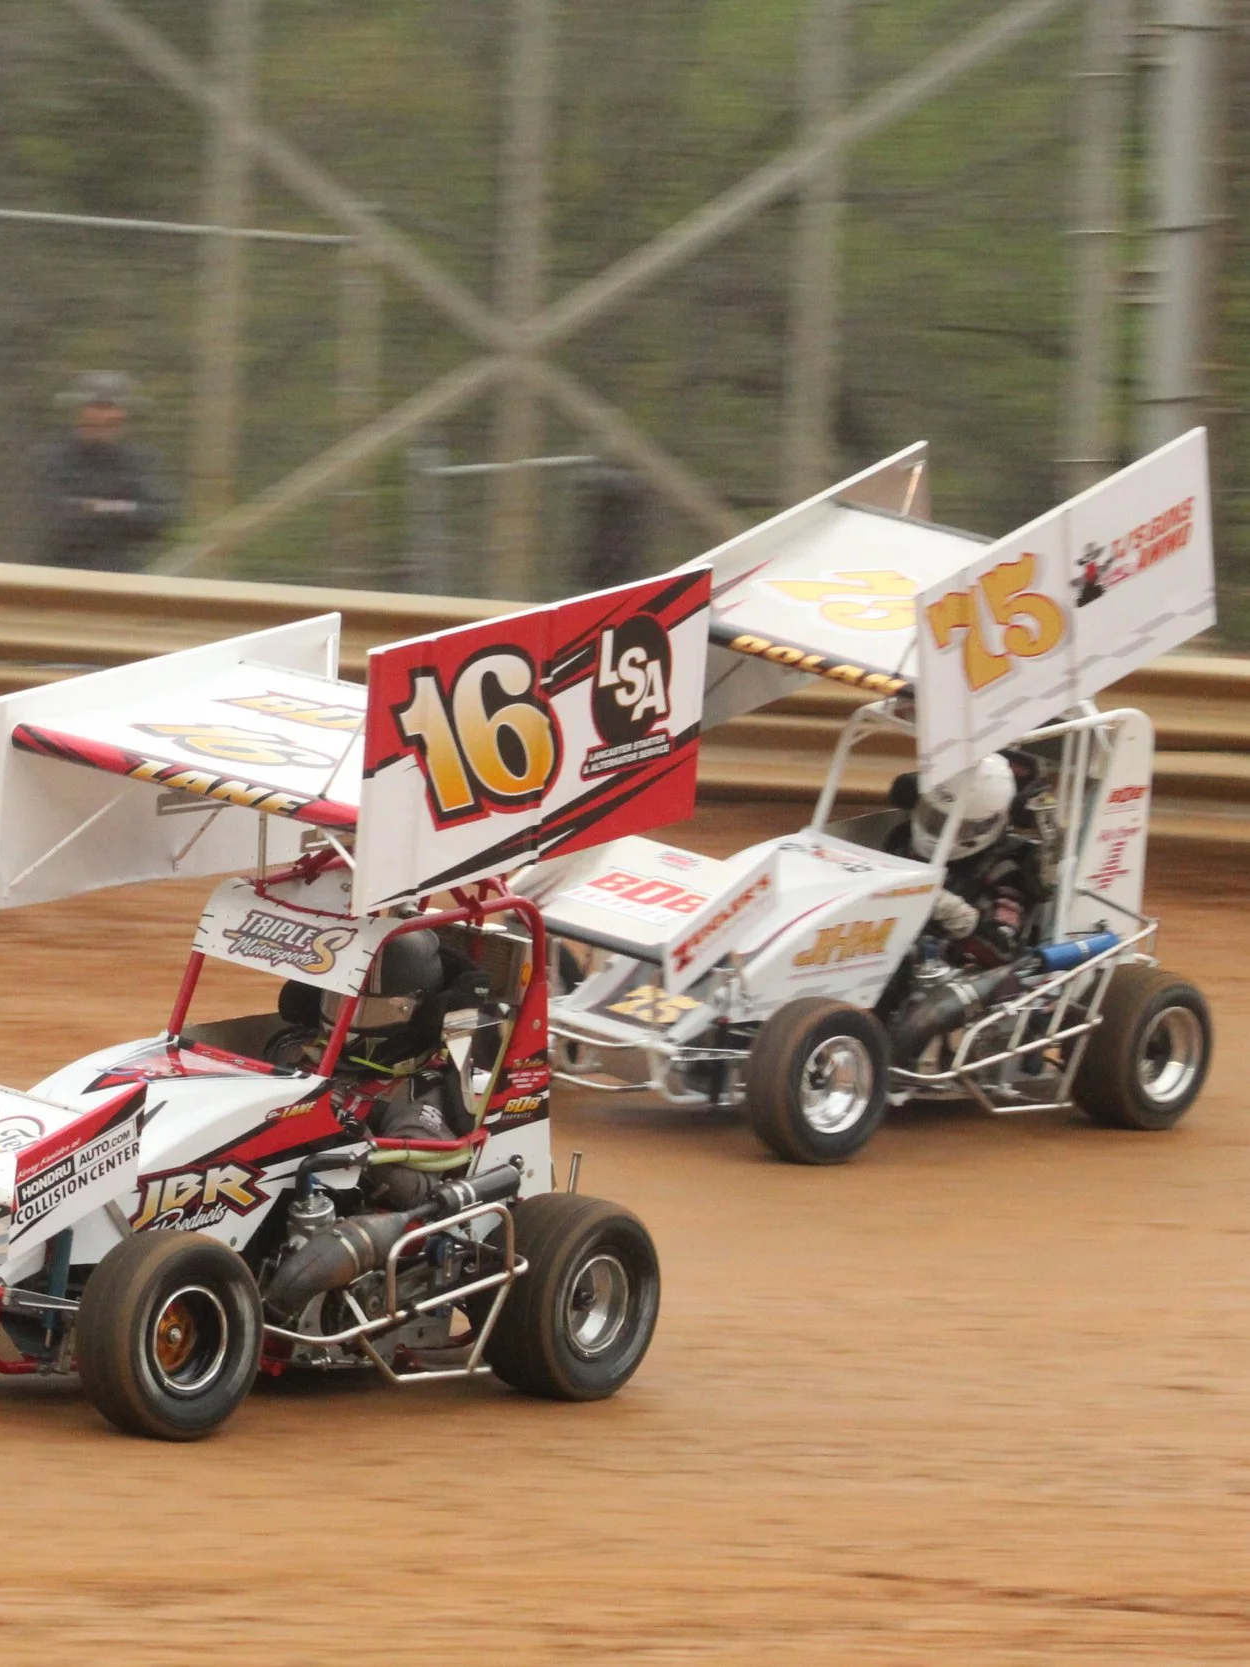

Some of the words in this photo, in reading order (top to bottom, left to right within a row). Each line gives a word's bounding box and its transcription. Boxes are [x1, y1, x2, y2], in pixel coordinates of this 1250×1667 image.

[924, 552, 1067, 692] 75
[597, 628, 669, 723] LSA
[398, 652, 556, 814] 16
[232, 935, 322, 967] Motorsports
[241, 913, 318, 948] TRIPLE
[302, 928, 356, 974] S
[15, 1172, 89, 1226] COLLISION
[89, 1142, 140, 1181] CENTER
[20, 1160, 73, 1201] HONDRU
[78, 1130, 131, 1167] AUTO.COM
[132, 1163, 256, 1232] JBR
[147, 1202, 229, 1232] Products
